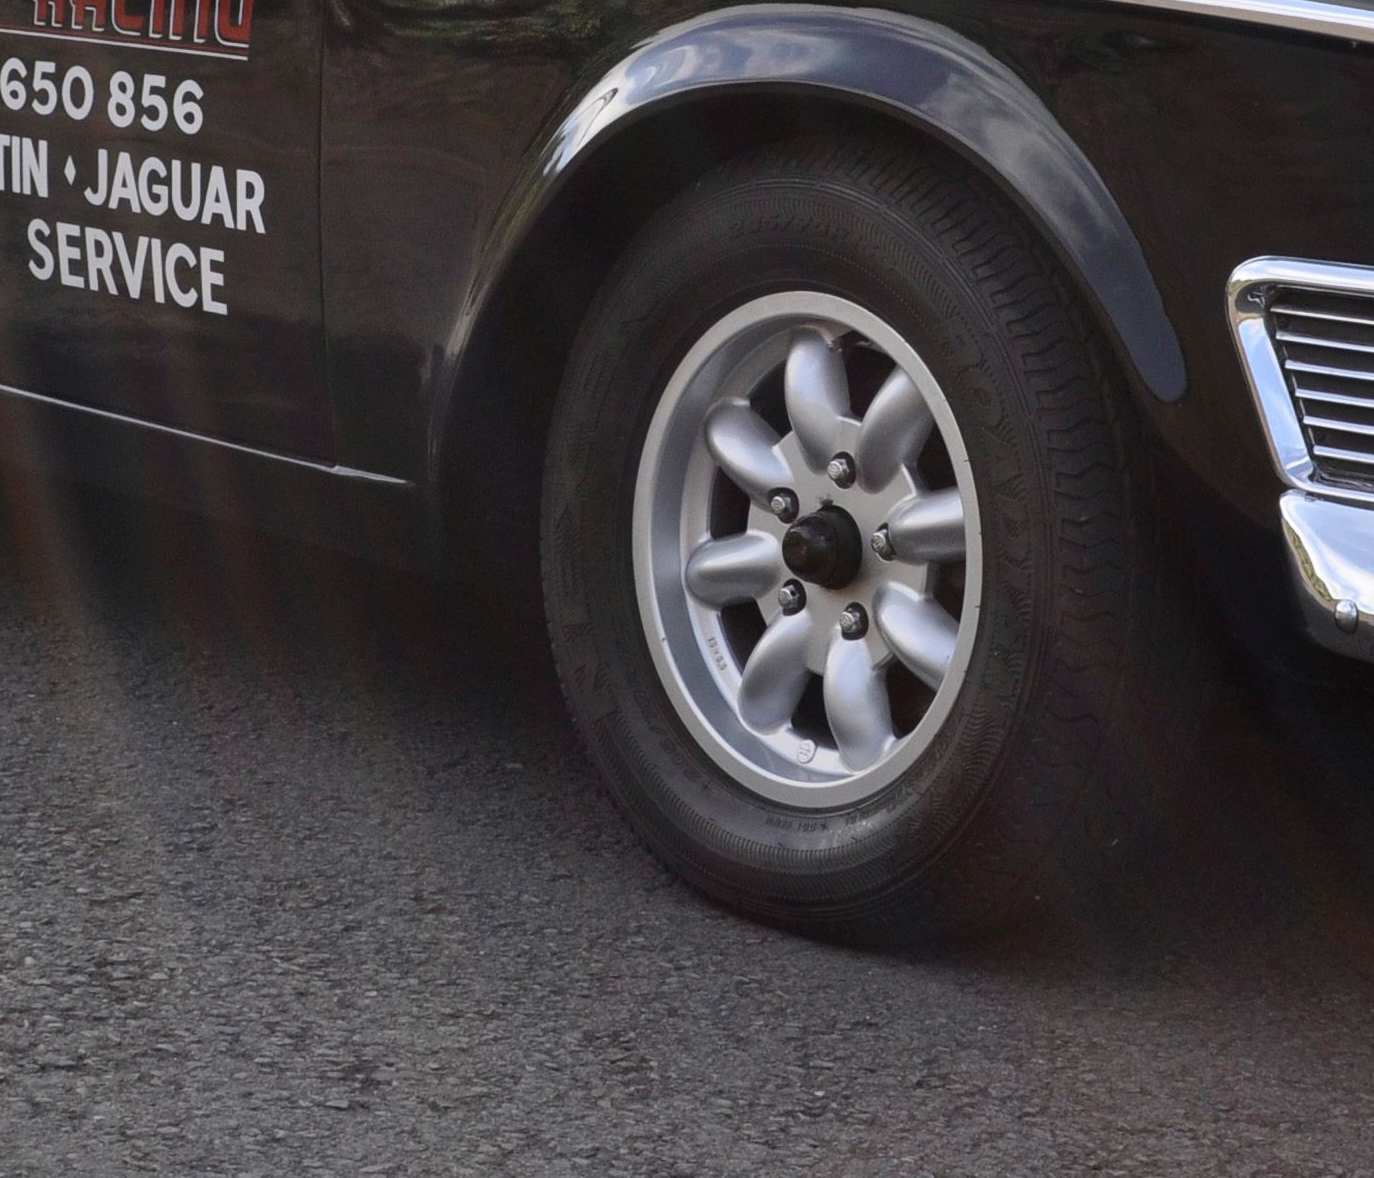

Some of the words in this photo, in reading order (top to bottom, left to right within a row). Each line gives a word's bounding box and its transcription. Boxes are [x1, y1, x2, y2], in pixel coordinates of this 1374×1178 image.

[0, 57, 94, 121] 650
[107, 70, 204, 135] 856
[83, 148, 266, 234] JAGUAR
[27, 218, 228, 315] SERVICE
